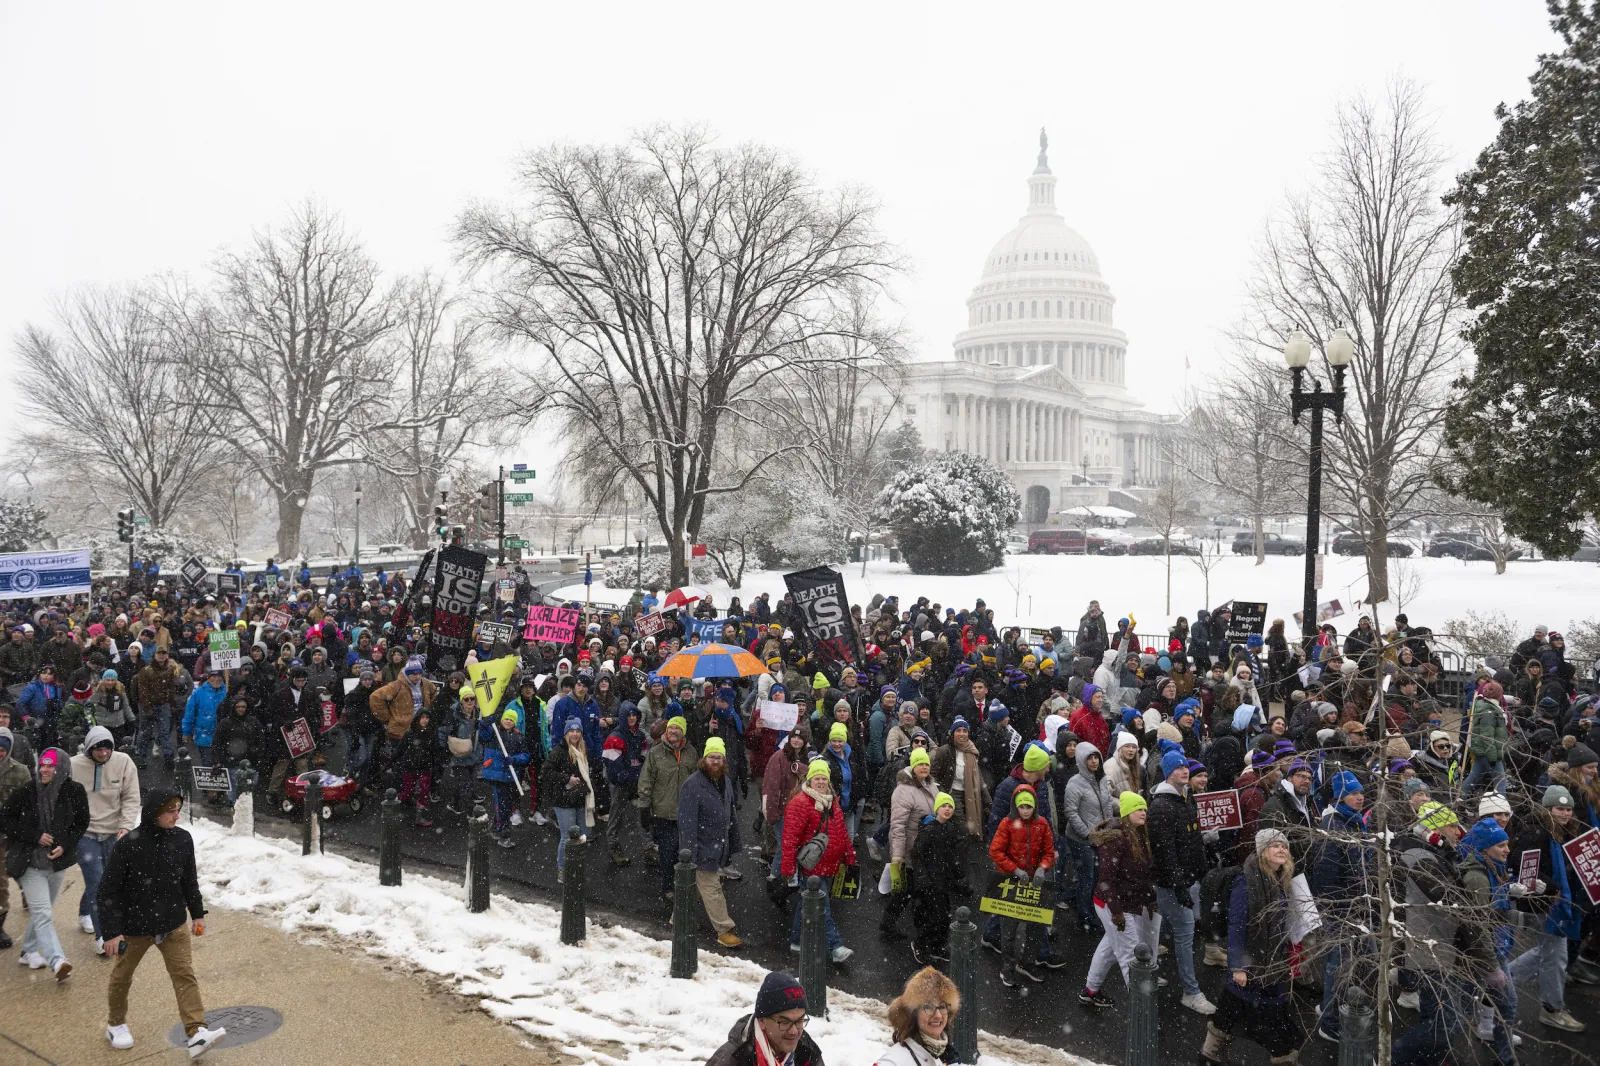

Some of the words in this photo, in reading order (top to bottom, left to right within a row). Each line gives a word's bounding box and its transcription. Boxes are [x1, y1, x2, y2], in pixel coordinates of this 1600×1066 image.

[0, 558, 36, 568] TENDOM
[443, 561, 480, 580] DEATH
[439, 572, 478, 603] IS
[794, 583, 838, 604] DEATH
[436, 596, 472, 616] NOT
[798, 596, 843, 628] IS
[1236, 615, 1261, 623] Regret
[341, 622, 352, 632] Jo
[640, 620, 660, 631] HEARTS
[644, 626, 658, 634] BEAT
[692, 624, 724, 636] LIFE
[210, 632, 224, 642] LOVE
[226, 631, 237, 640] LIFE
[214, 651, 237, 660] CHOOSE
[220, 660, 232, 668] LIFE
[324, 704, 333, 726] BOTH
[286, 731, 299, 748] BEAT
[1208, 798, 1232, 807] THEIR
[1200, 815, 1228, 827] BEAT
[1522, 866, 1536, 878] HEARTS
[1575, 854, 1599, 886] BEAT
[1016, 888, 1041, 899] LIFE
